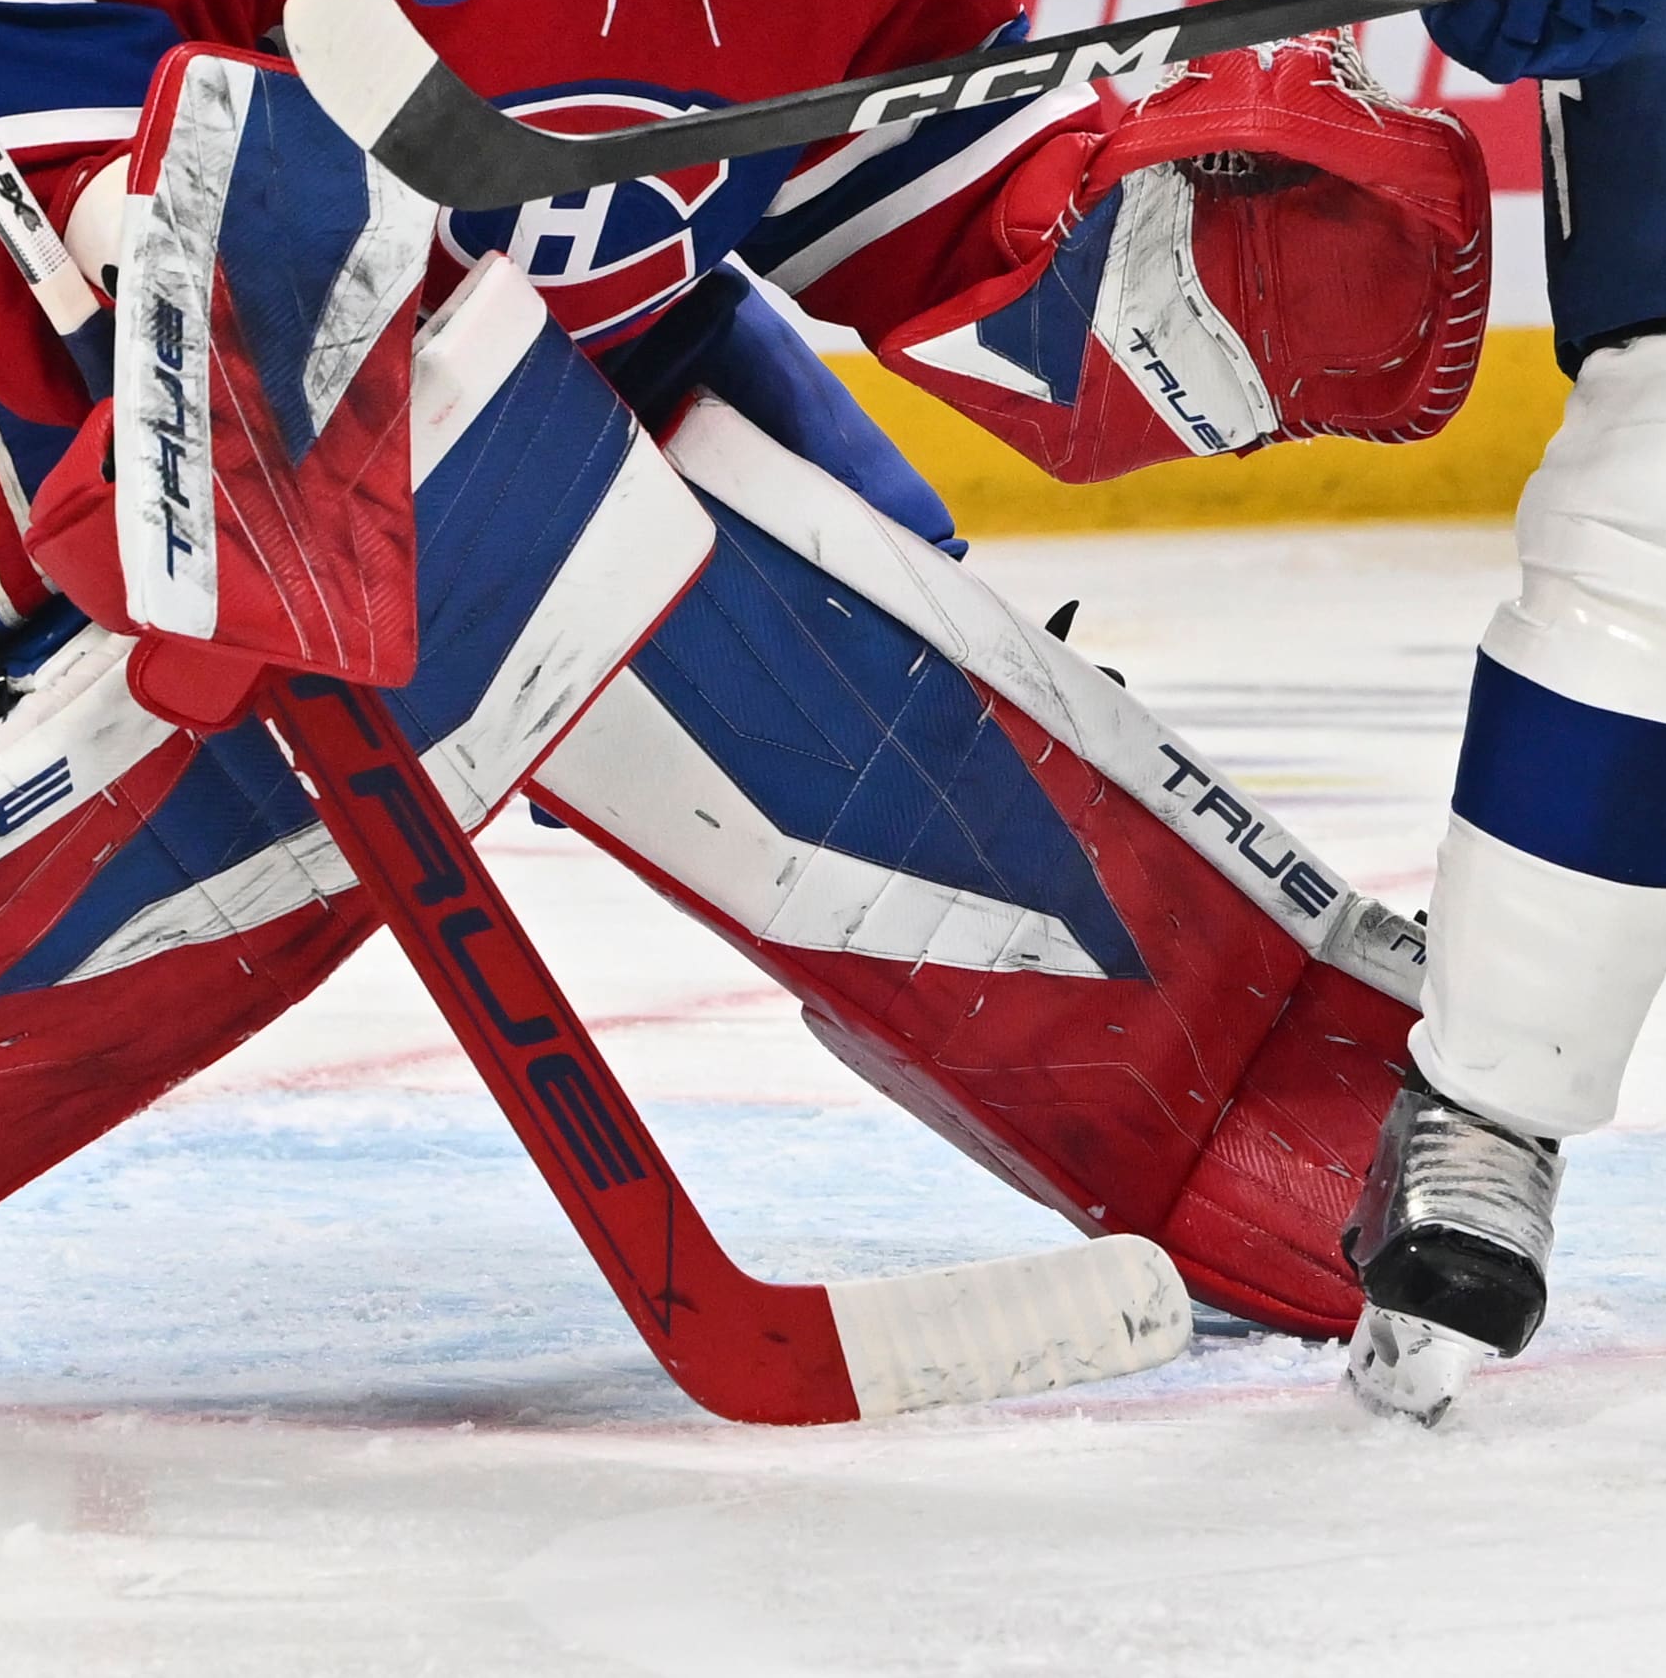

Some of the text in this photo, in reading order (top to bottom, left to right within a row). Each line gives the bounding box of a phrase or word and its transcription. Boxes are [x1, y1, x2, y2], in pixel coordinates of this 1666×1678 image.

[847, 24, 1182, 134] CCM
[152, 296, 194, 582] TRUE
[1129, 326, 1230, 451] TRUE
[1158, 743, 1339, 919] TRUE
[289, 672, 649, 1193] TRUE
